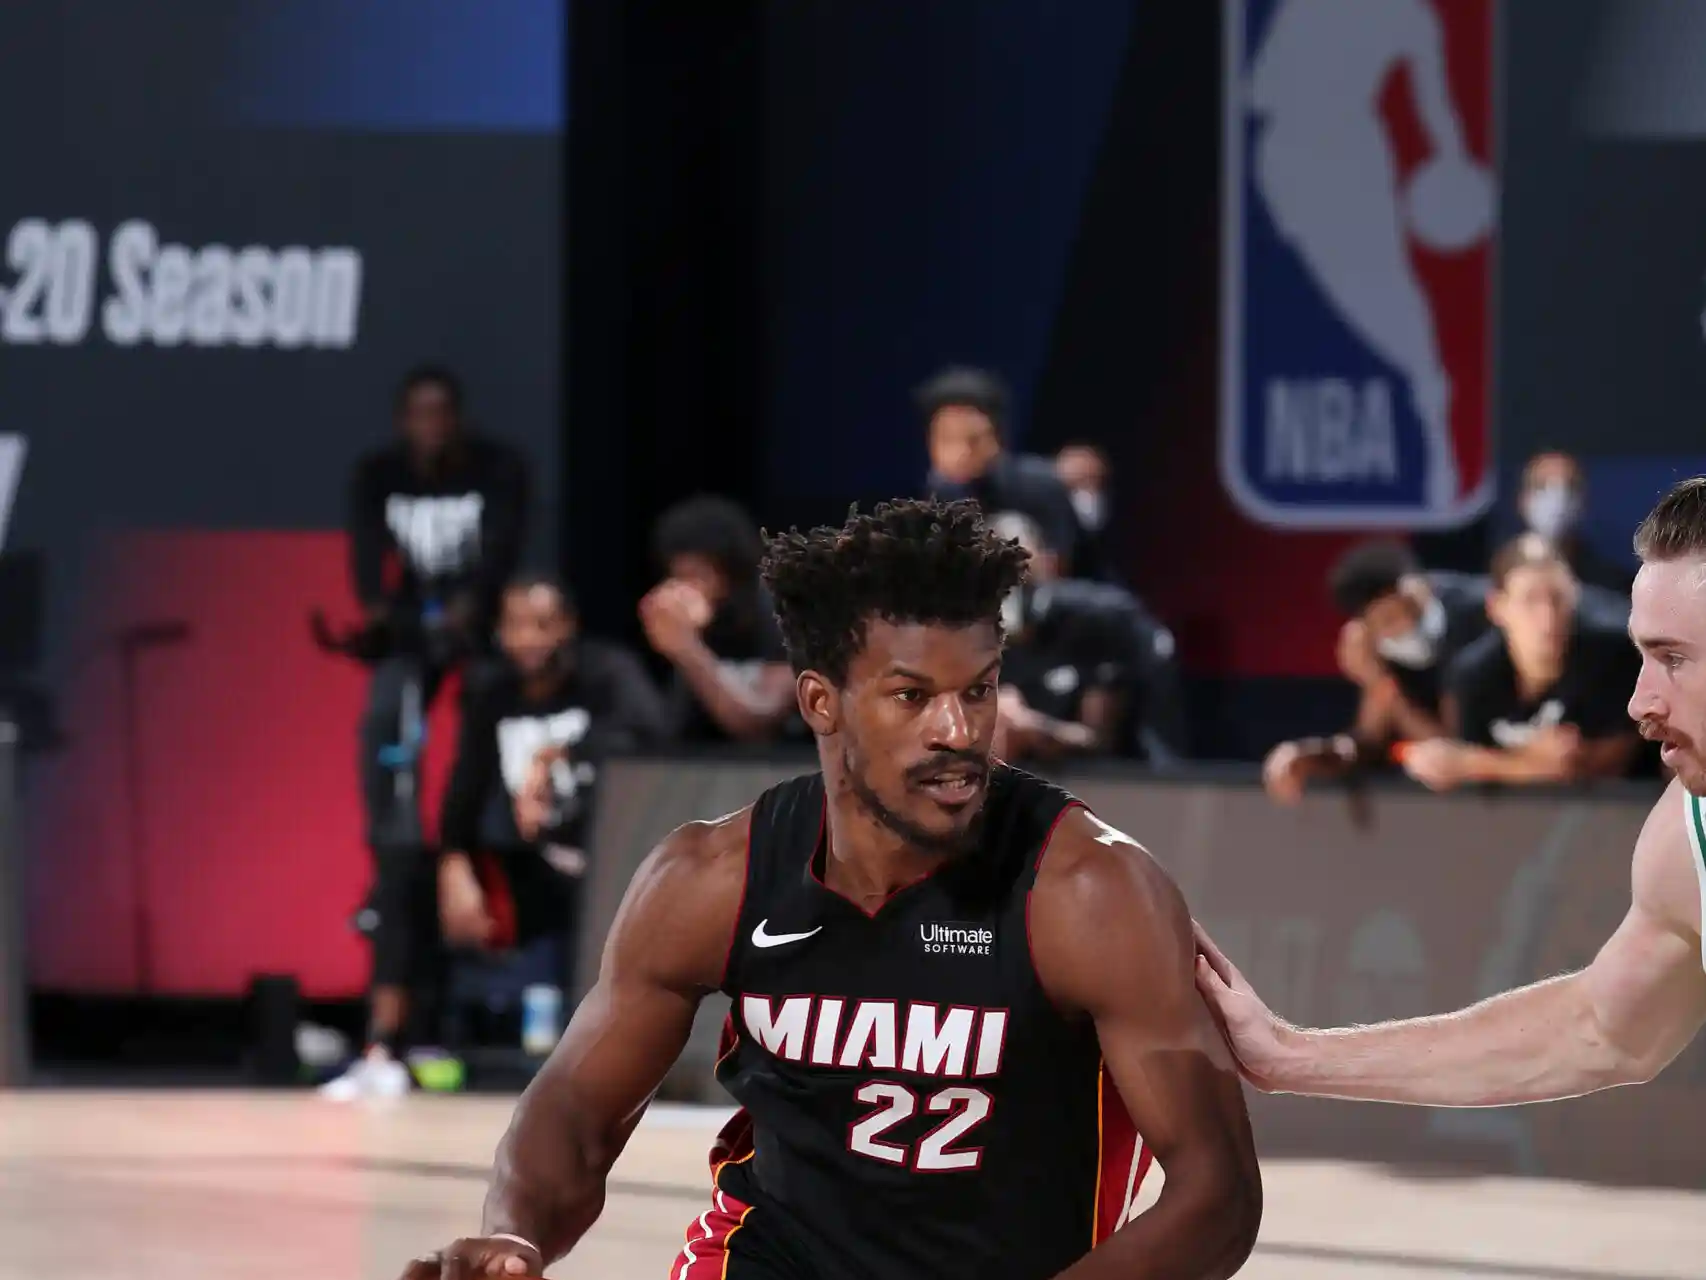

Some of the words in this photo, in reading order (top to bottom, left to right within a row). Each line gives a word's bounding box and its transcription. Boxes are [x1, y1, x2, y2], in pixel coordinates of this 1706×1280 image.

[102, 218, 362, 348] Season
[1264, 377, 1396, 484] NBA
[920, 923, 993, 944] Ultimate
[924, 943, 990, 955] SOFTWARE
[742, 993, 1009, 1077] MIAMI
[848, 1079, 994, 1172] 22
